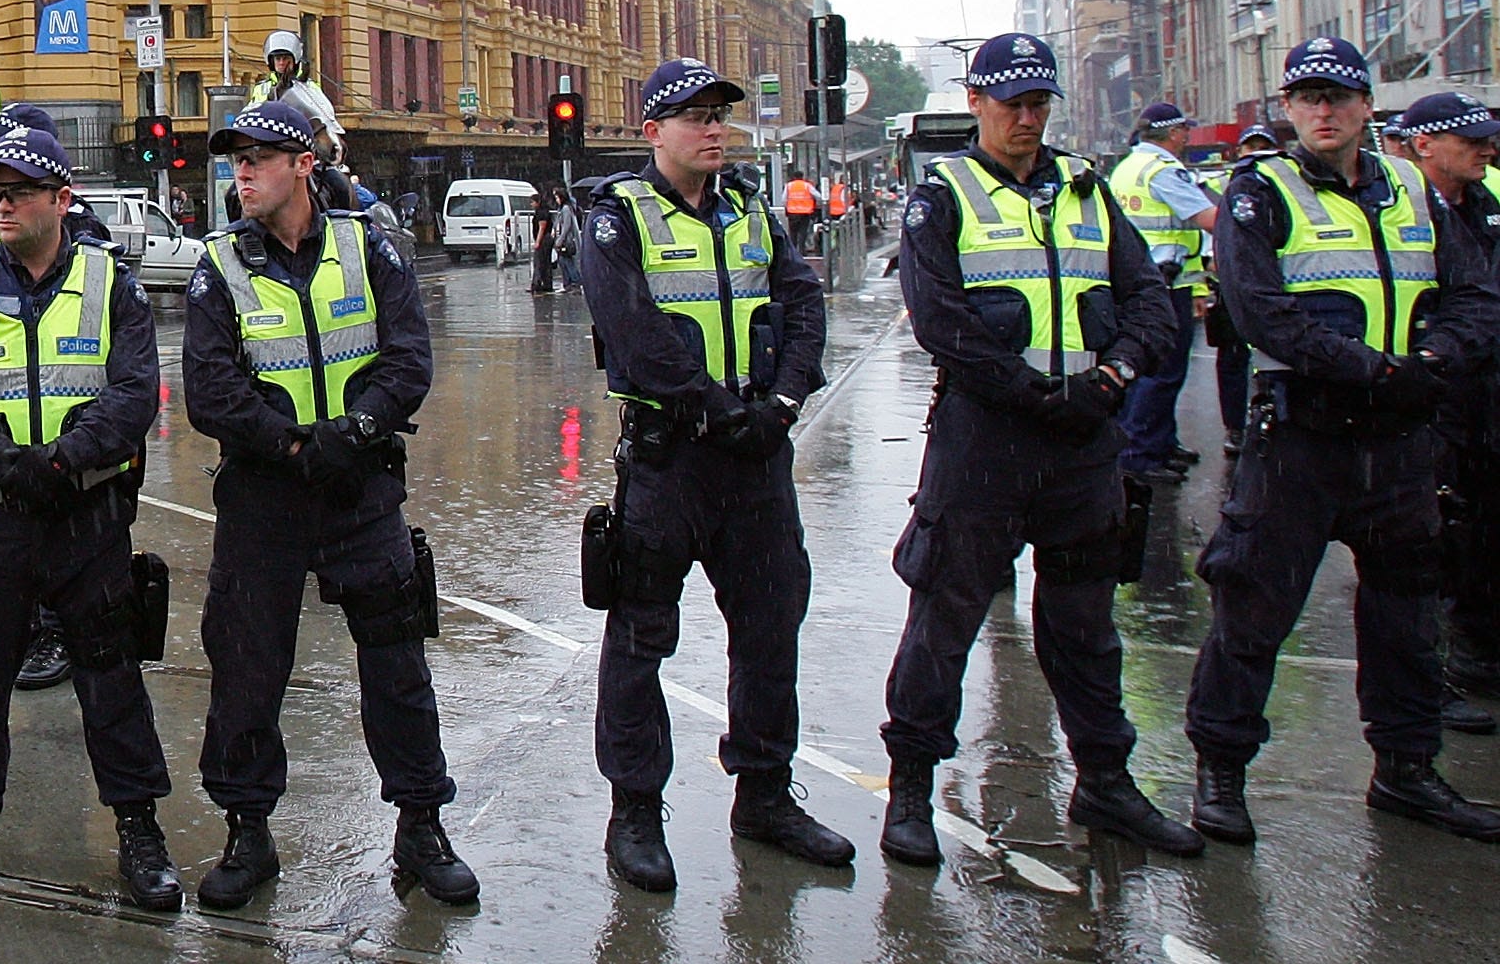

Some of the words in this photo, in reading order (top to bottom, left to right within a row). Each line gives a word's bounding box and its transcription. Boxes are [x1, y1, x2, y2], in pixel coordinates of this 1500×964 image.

[49, 36, 79, 45] METRO
[331, 298, 365, 315] Police
[59, 339, 99, 352] Police
